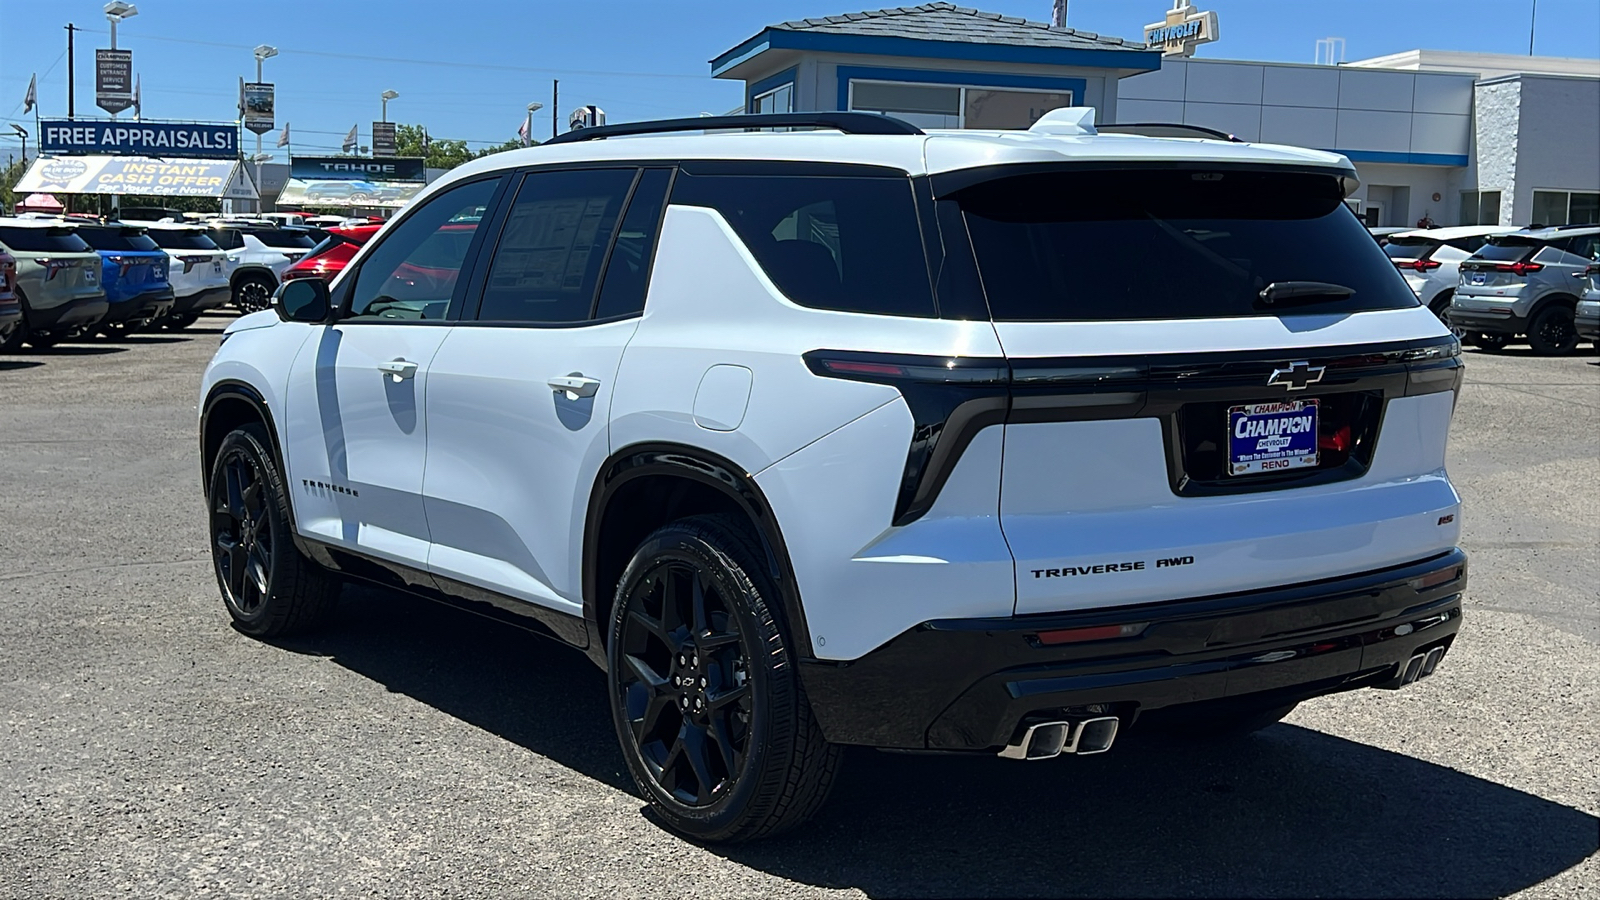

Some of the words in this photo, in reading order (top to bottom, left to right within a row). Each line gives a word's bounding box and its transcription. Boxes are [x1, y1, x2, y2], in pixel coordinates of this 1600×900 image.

[1147, 21, 1201, 45] CHEVROLET
[47, 127, 96, 146] FREE
[101, 128, 232, 149] APPRAISALS!
[122, 163, 210, 175] INSTANT
[320, 163, 396, 174] TAHOE
[98, 173, 151, 184] CASH
[157, 175, 223, 187] OFFER
[96, 184, 119, 192] For
[121, 184, 151, 194] Your
[179, 186, 214, 195] Now!
[1254, 402, 1297, 414] CHAMPION
[1235, 416, 1312, 439] CHAMPION
[1259, 438, 1289, 448] CHEVROLET
[1261, 459, 1290, 470] RENO
[302, 479, 359, 498] TRAVERSE
[1437, 514, 1455, 526] RS
[1031, 561, 1145, 578] TRAVERSE
[1156, 556, 1194, 568] AWD
